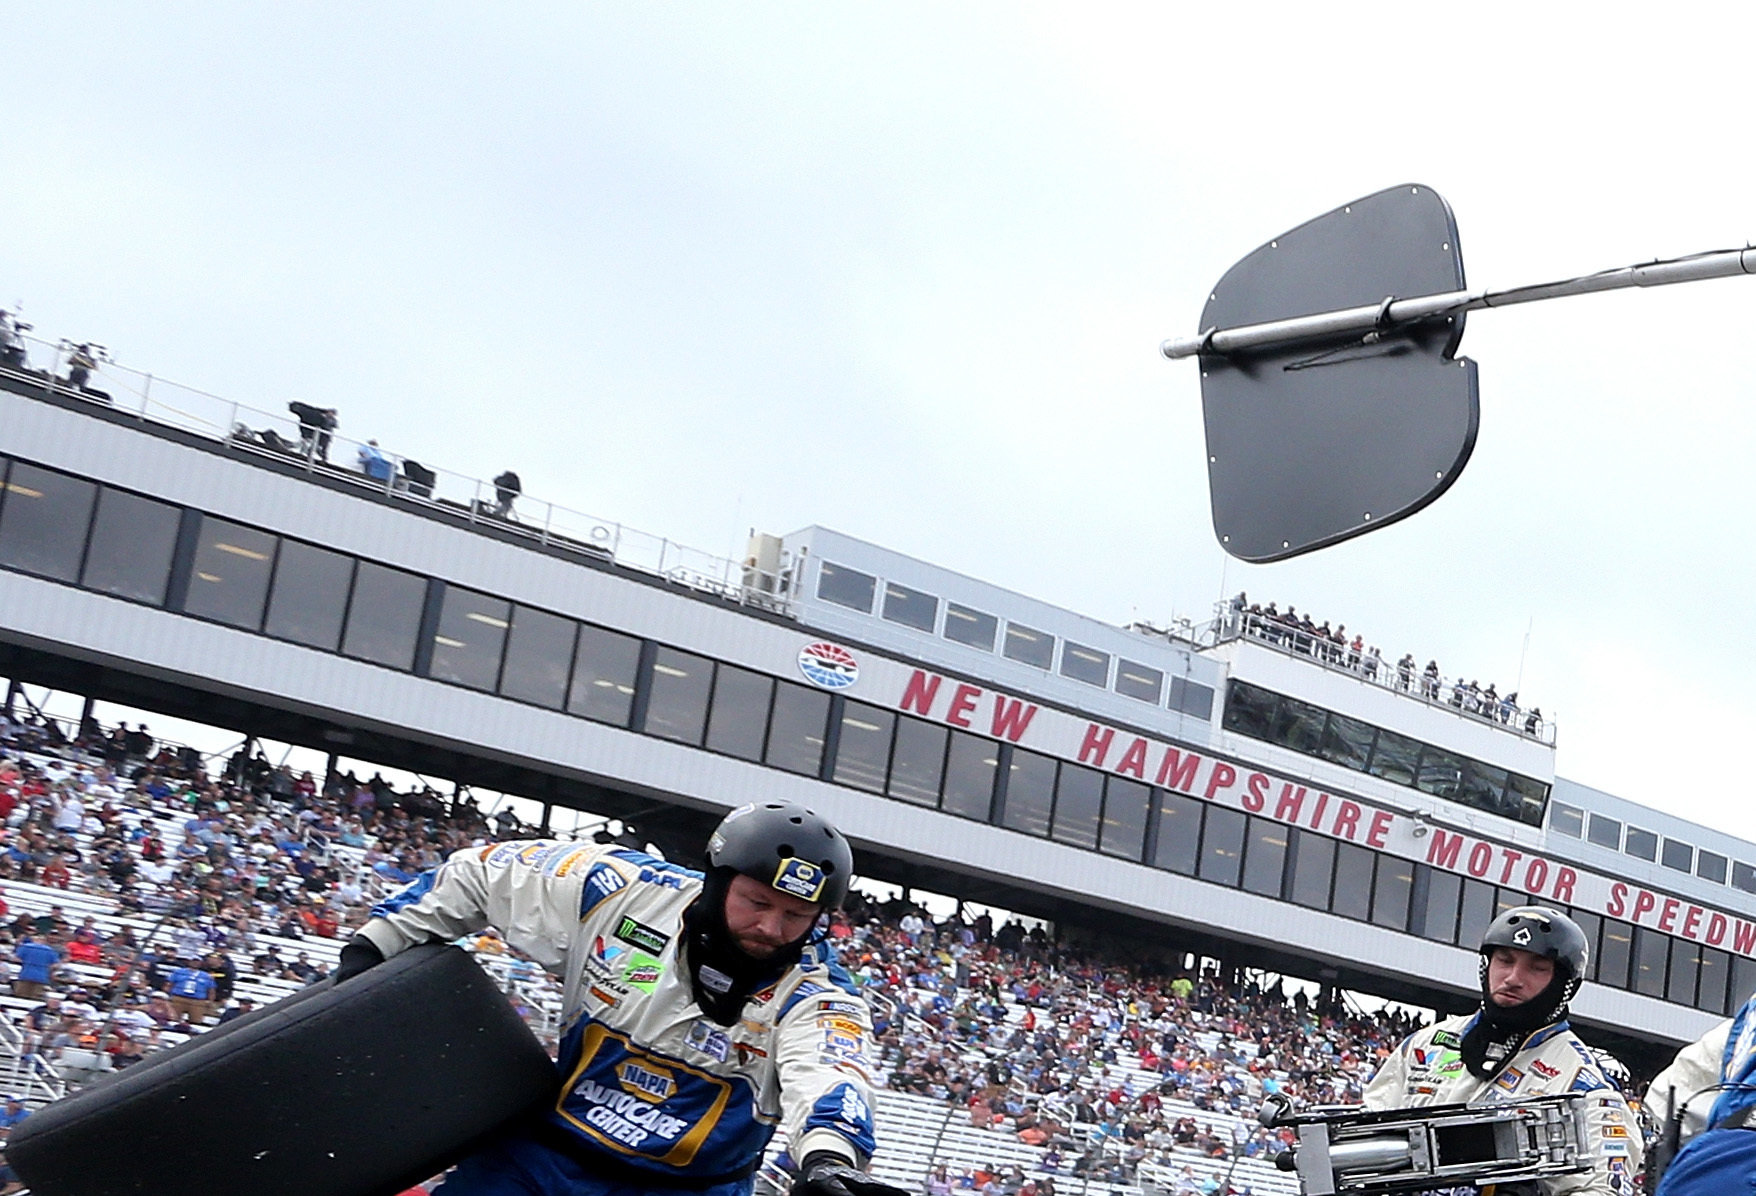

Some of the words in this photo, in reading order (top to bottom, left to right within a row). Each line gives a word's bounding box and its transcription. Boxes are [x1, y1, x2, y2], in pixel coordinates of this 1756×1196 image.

[900, 670, 1037, 742] NEW
[1077, 723, 1394, 849] HAMPSHIRE
[1427, 828, 1578, 903] MOTOR
[625, 1065, 668, 1095] NAPA
[574, 1080, 688, 1140] AUTOCARE
[586, 1106, 648, 1147] CENTER
